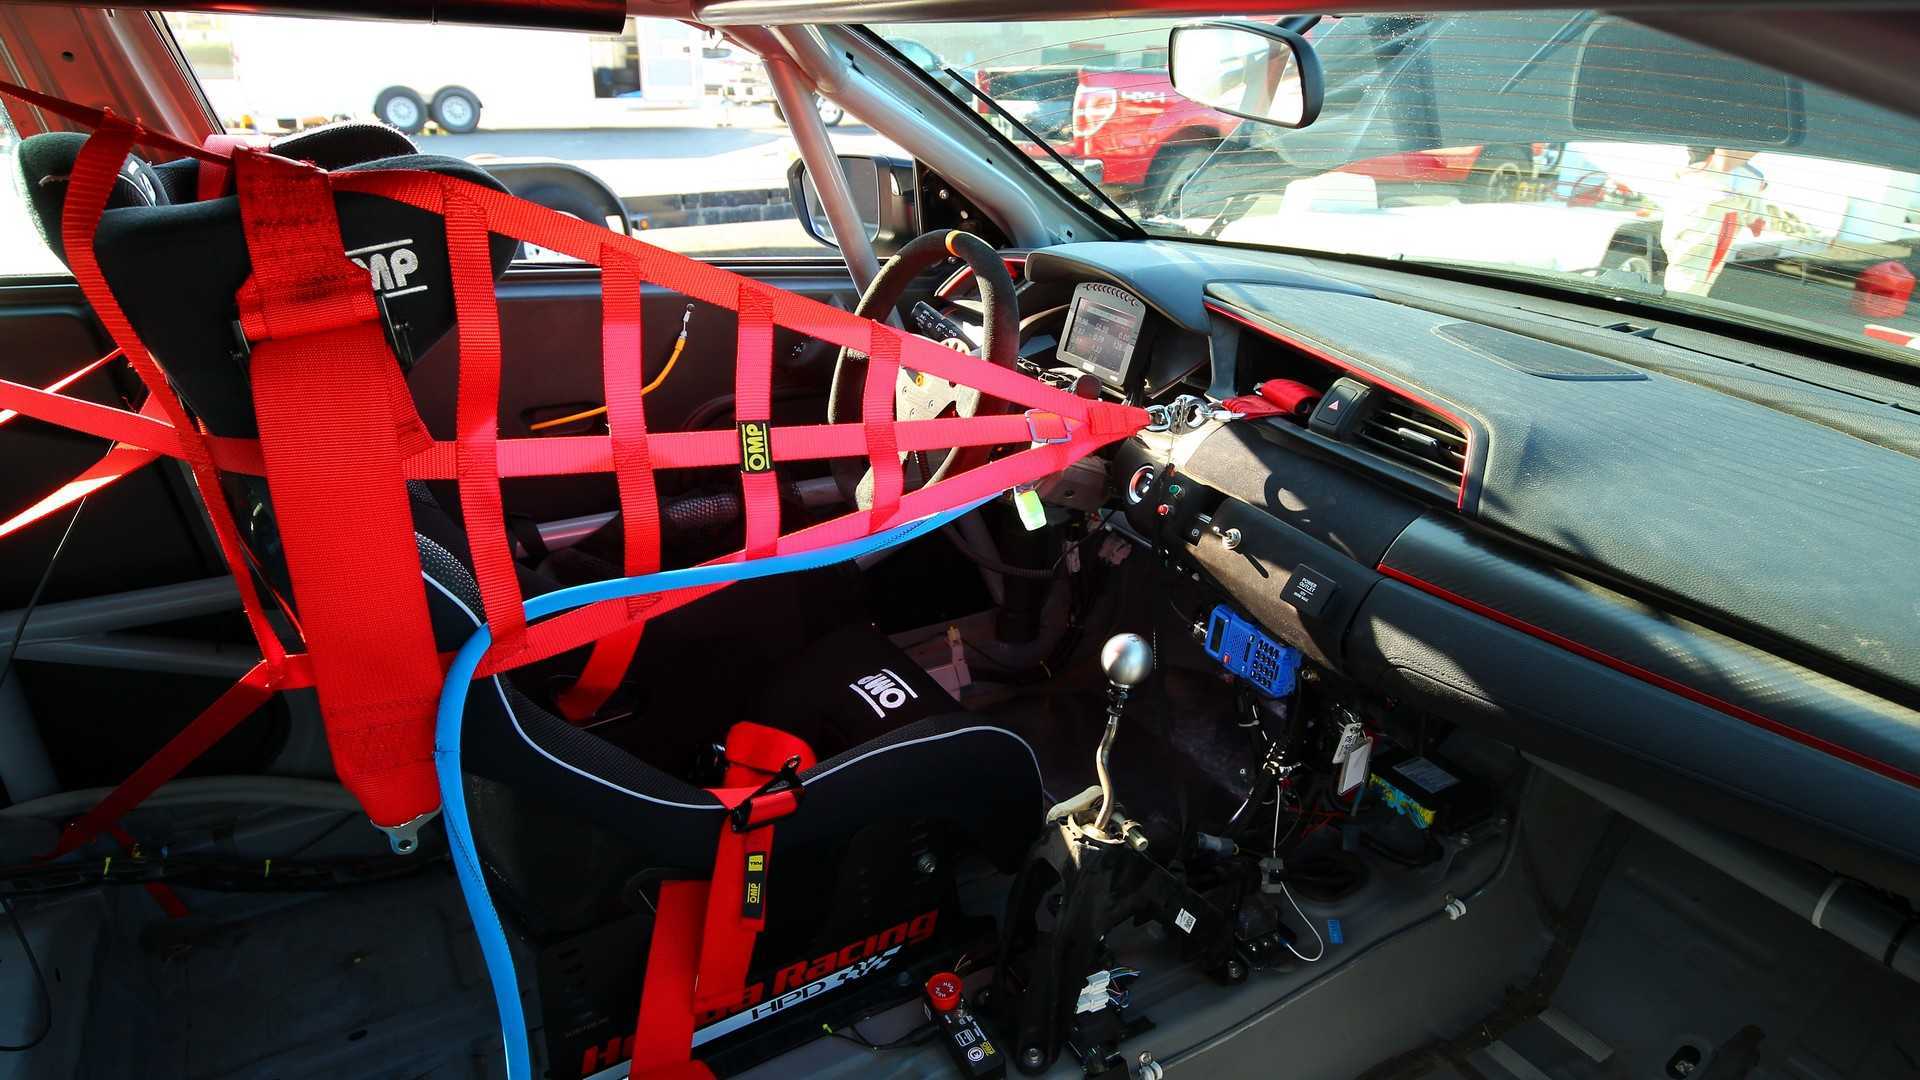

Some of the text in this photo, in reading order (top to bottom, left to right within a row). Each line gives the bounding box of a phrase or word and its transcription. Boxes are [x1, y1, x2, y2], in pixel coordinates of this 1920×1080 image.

[351, 248, 419, 291] MP
[746, 423, 766, 471] OMP
[857, 673, 906, 709] OMP
[749, 883, 758, 904] OMP
[772, 908, 939, 996] Racing
[751, 981, 827, 1021] HPD
